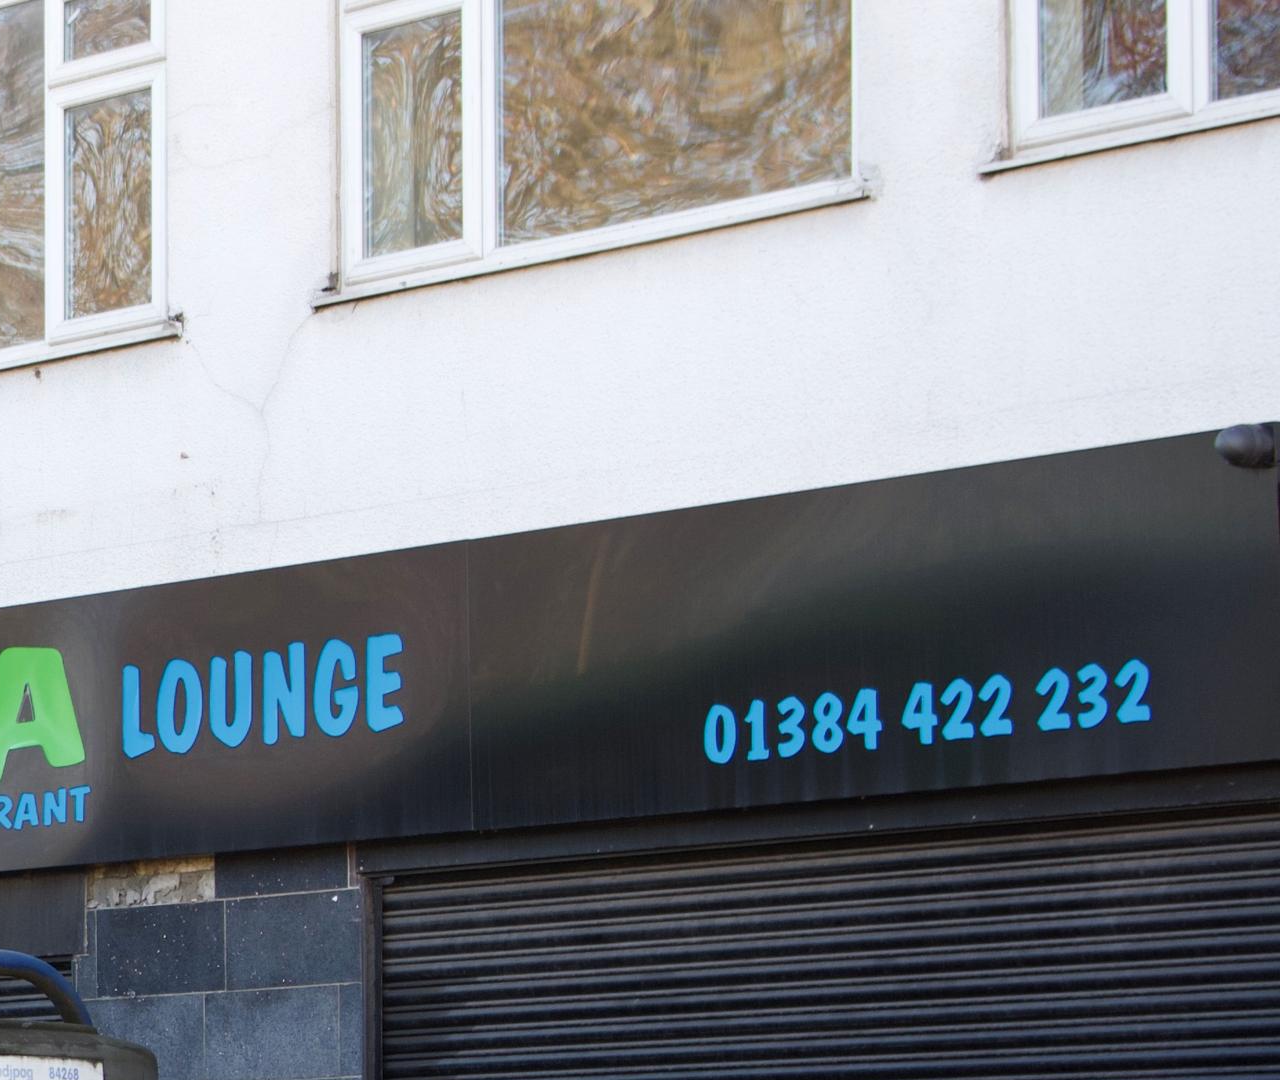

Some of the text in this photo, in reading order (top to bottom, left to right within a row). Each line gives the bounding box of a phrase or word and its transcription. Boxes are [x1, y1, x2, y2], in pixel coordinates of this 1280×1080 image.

[122, 632, 404, 759] LOUNGE
[703, 657, 1152, 765] 01384 422 232
[48, 1066, 79, 1080] 84268
